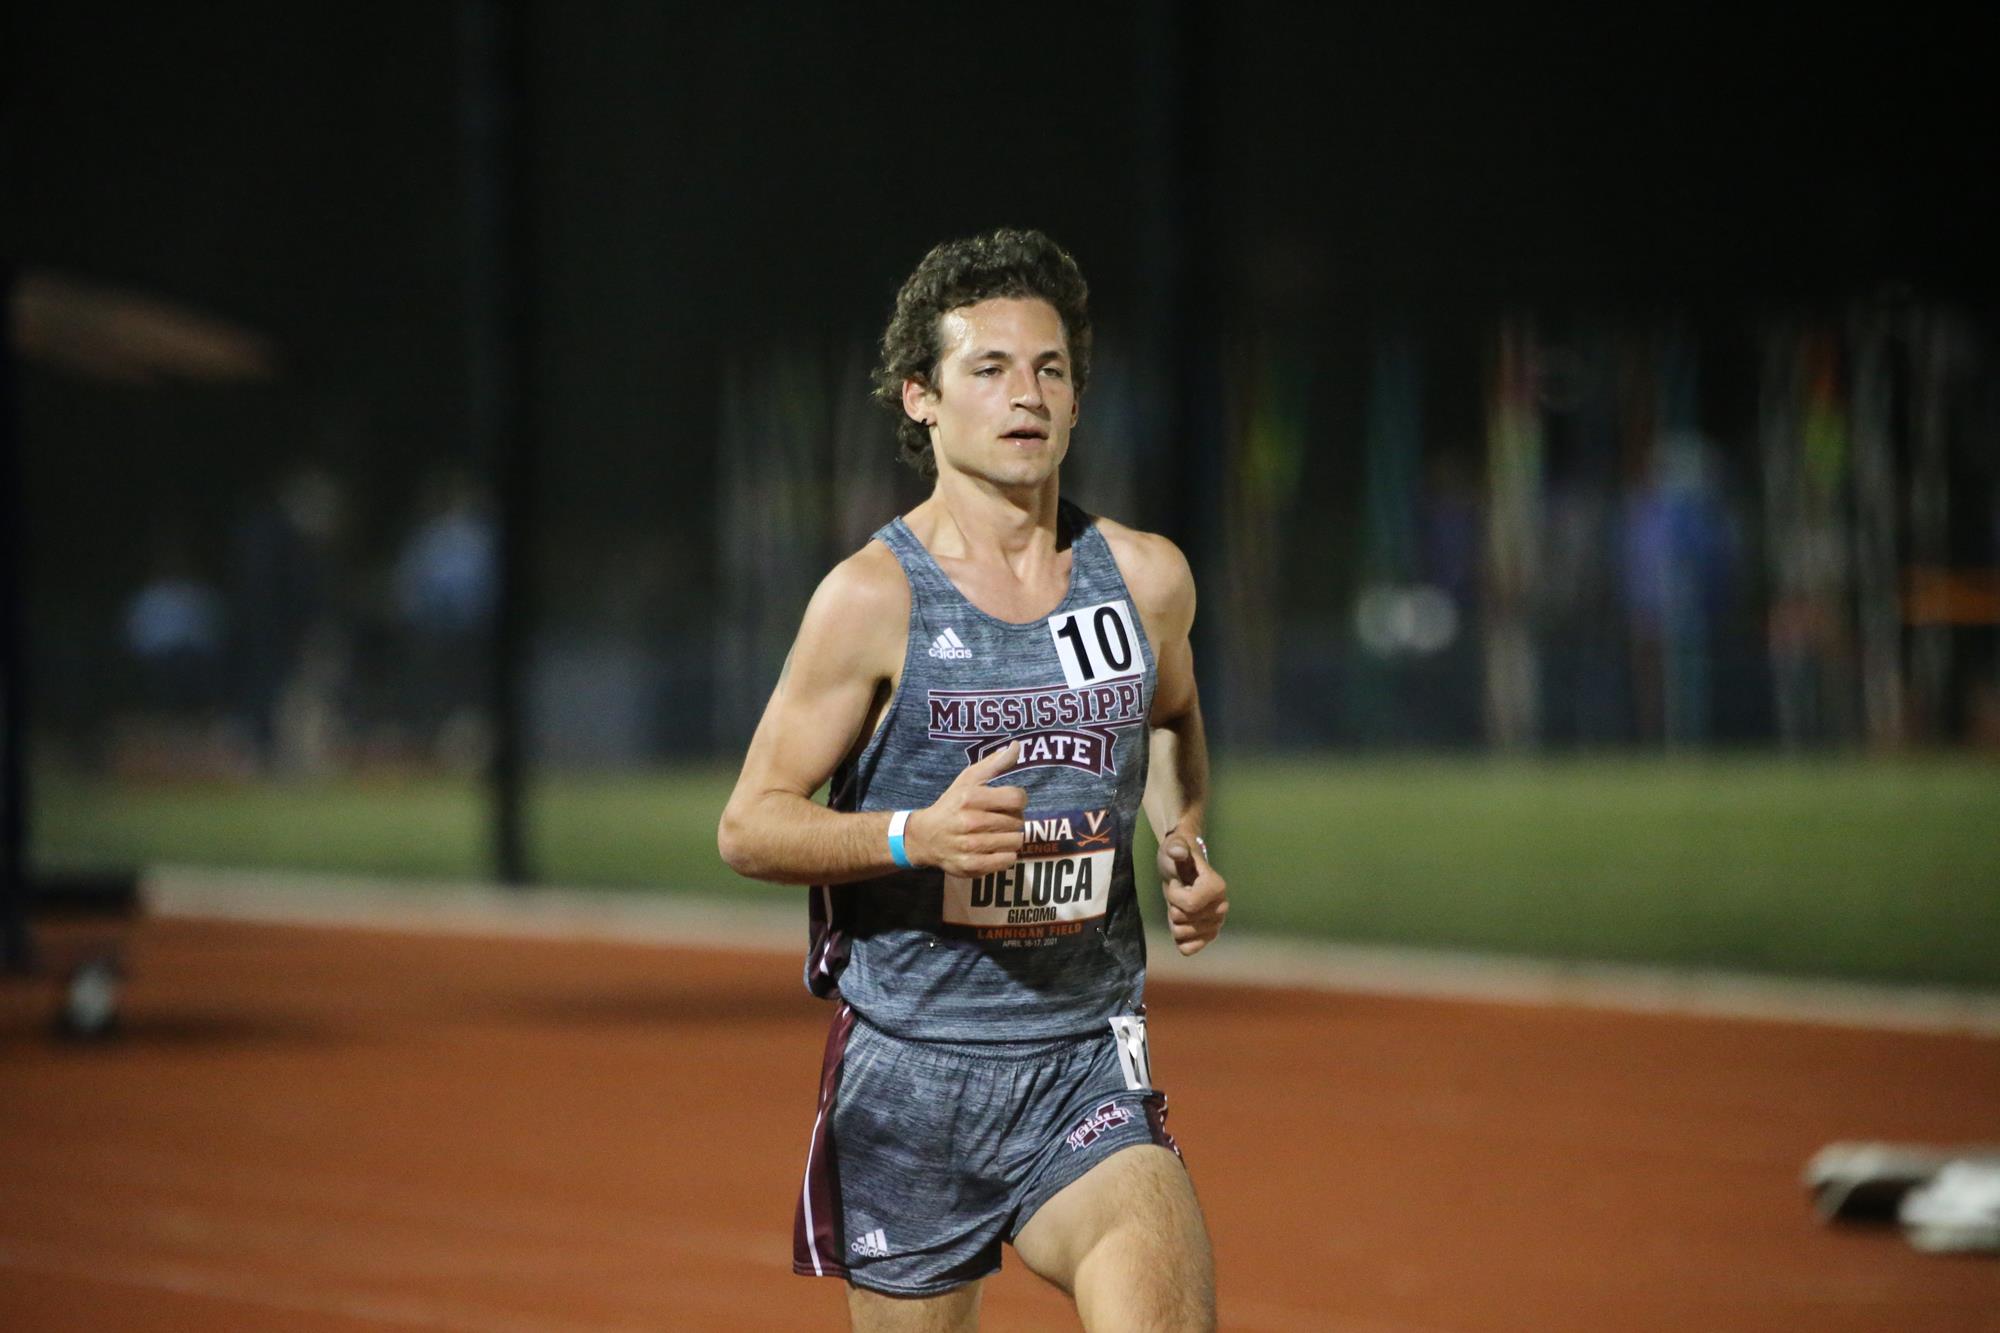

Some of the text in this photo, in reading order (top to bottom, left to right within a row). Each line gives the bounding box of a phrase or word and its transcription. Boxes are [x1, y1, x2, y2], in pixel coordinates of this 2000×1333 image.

[928, 647, 973, 660] adidas
[1057, 606, 1132, 681] 10
[928, 682, 1144, 733] MISSISSIPPI
[1001, 736, 1091, 765] TATE
[970, 857, 1093, 908] DELUCA
[1007, 906, 1057, 924] GIACOMO
[977, 923, 1082, 940] LANNIGAN FIELD
